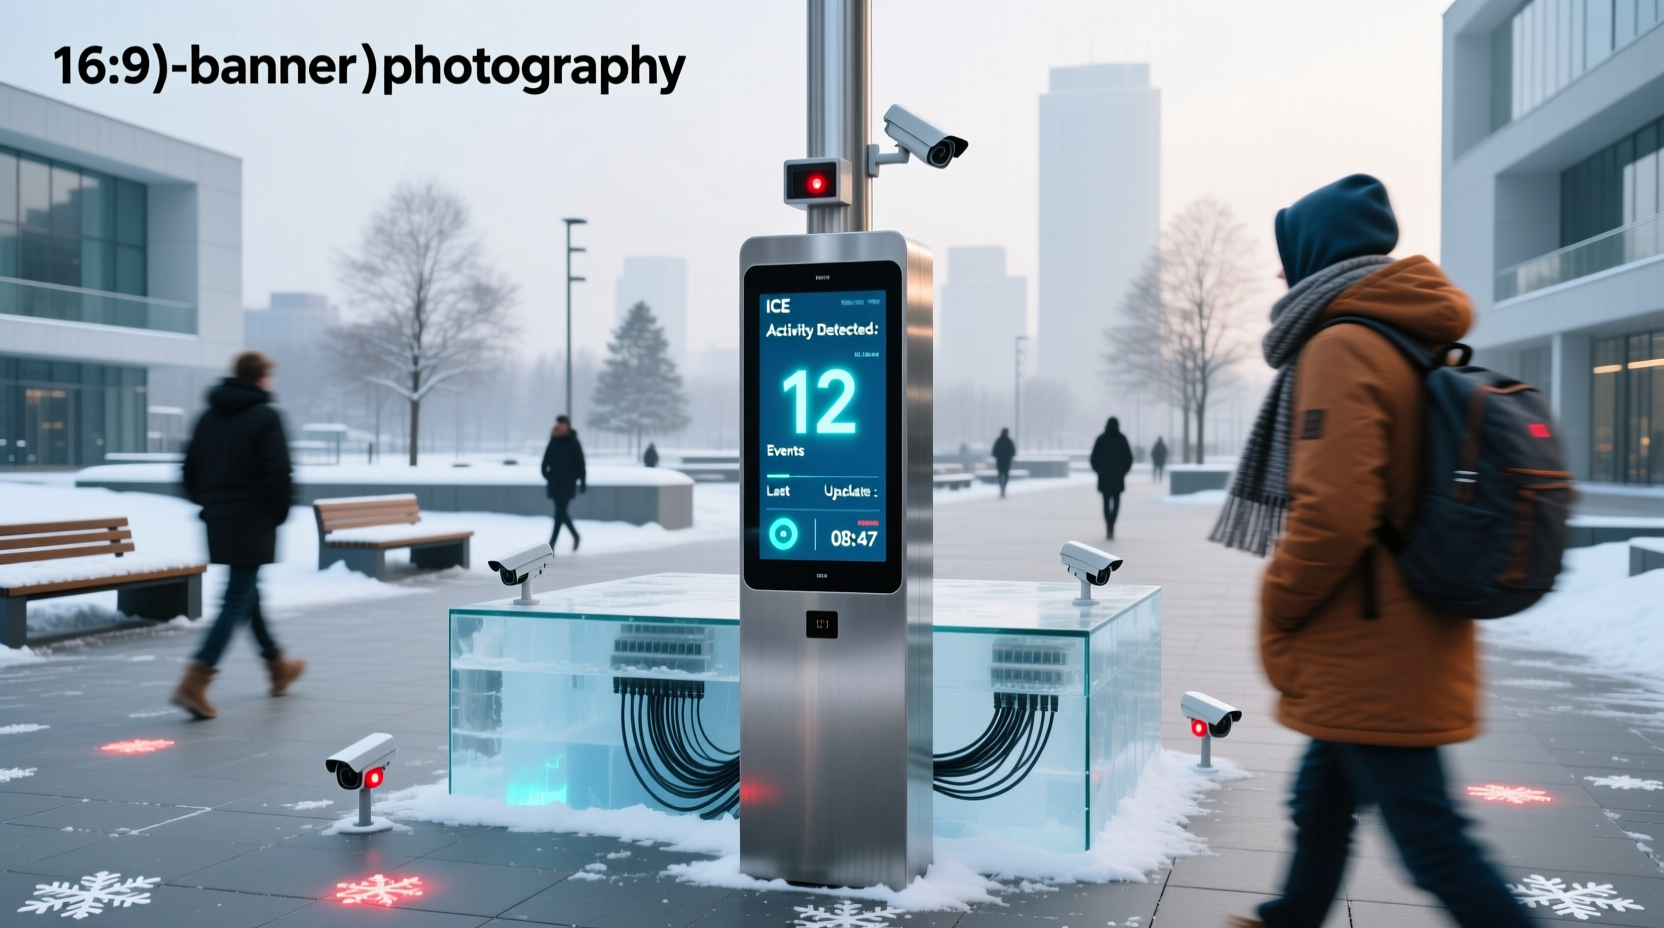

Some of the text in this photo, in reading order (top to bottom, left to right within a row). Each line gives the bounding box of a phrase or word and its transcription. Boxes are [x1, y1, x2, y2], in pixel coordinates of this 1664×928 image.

[766, 298, 791, 314] ICE
[765, 321, 879, 341] Activity Detected:
[783, 368, 856, 434] 12
[766, 444, 805, 457] Events
[830, 530, 878, 547] 08:47
